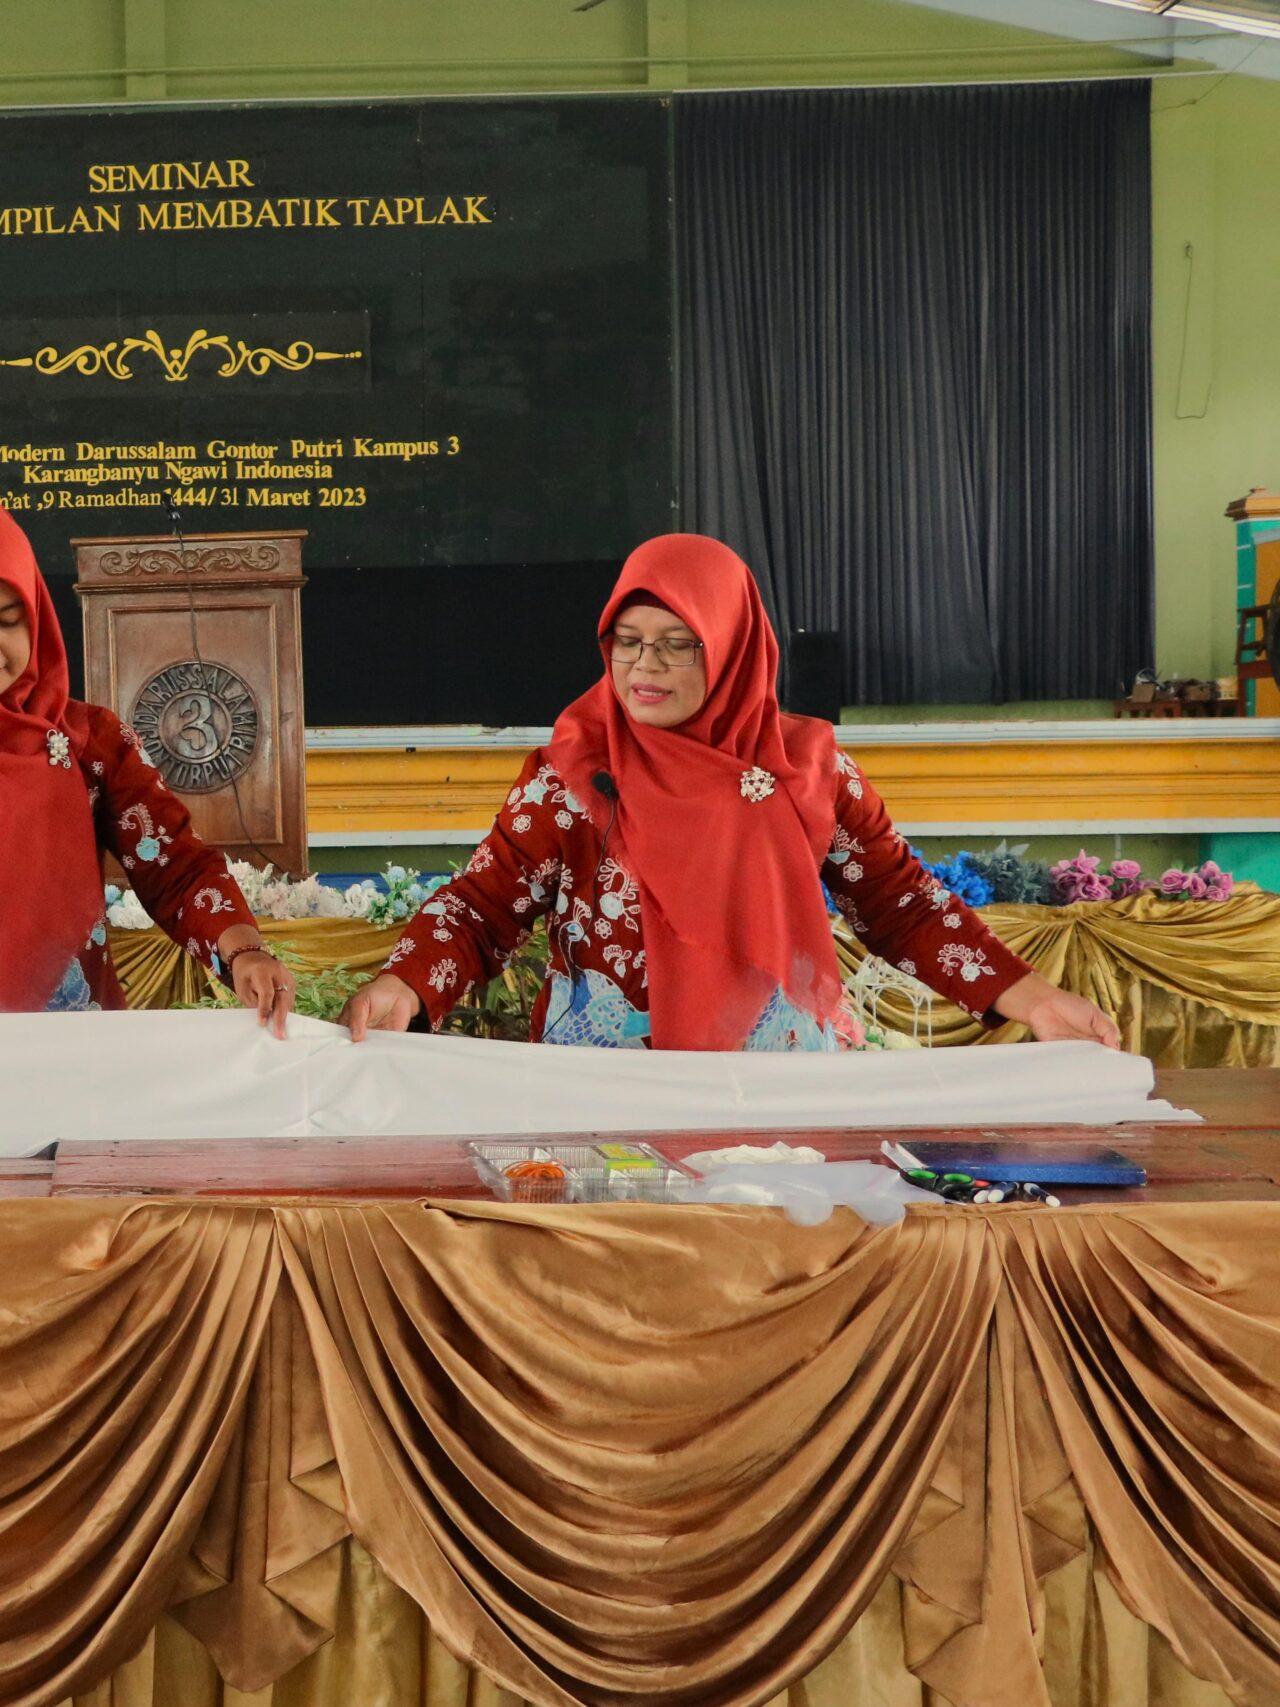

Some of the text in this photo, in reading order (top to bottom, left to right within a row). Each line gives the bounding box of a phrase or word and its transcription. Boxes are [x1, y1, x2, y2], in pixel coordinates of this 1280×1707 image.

[88, 159, 255, 194] SEMINAR
[137, 197, 341, 231] MEMBATIK
[346, 195, 492, 226] TAPLAK
[76, 440, 197, 462] Darussalam
[206, 439, 278, 460] Gontor
[290, 437, 344, 459] Putri
[353, 437, 439, 462] Kampus
[447, 435, 460, 456] 3
[23, 459, 333, 487] Karangbanyu Ngawi Indonesia
[58, 487, 162, 509] Ramadhan
[220, 487, 239, 506] 31
[246, 487, 312, 508] Maret
[318, 486, 367, 507] 2023
[179, 693, 219, 759] 3
